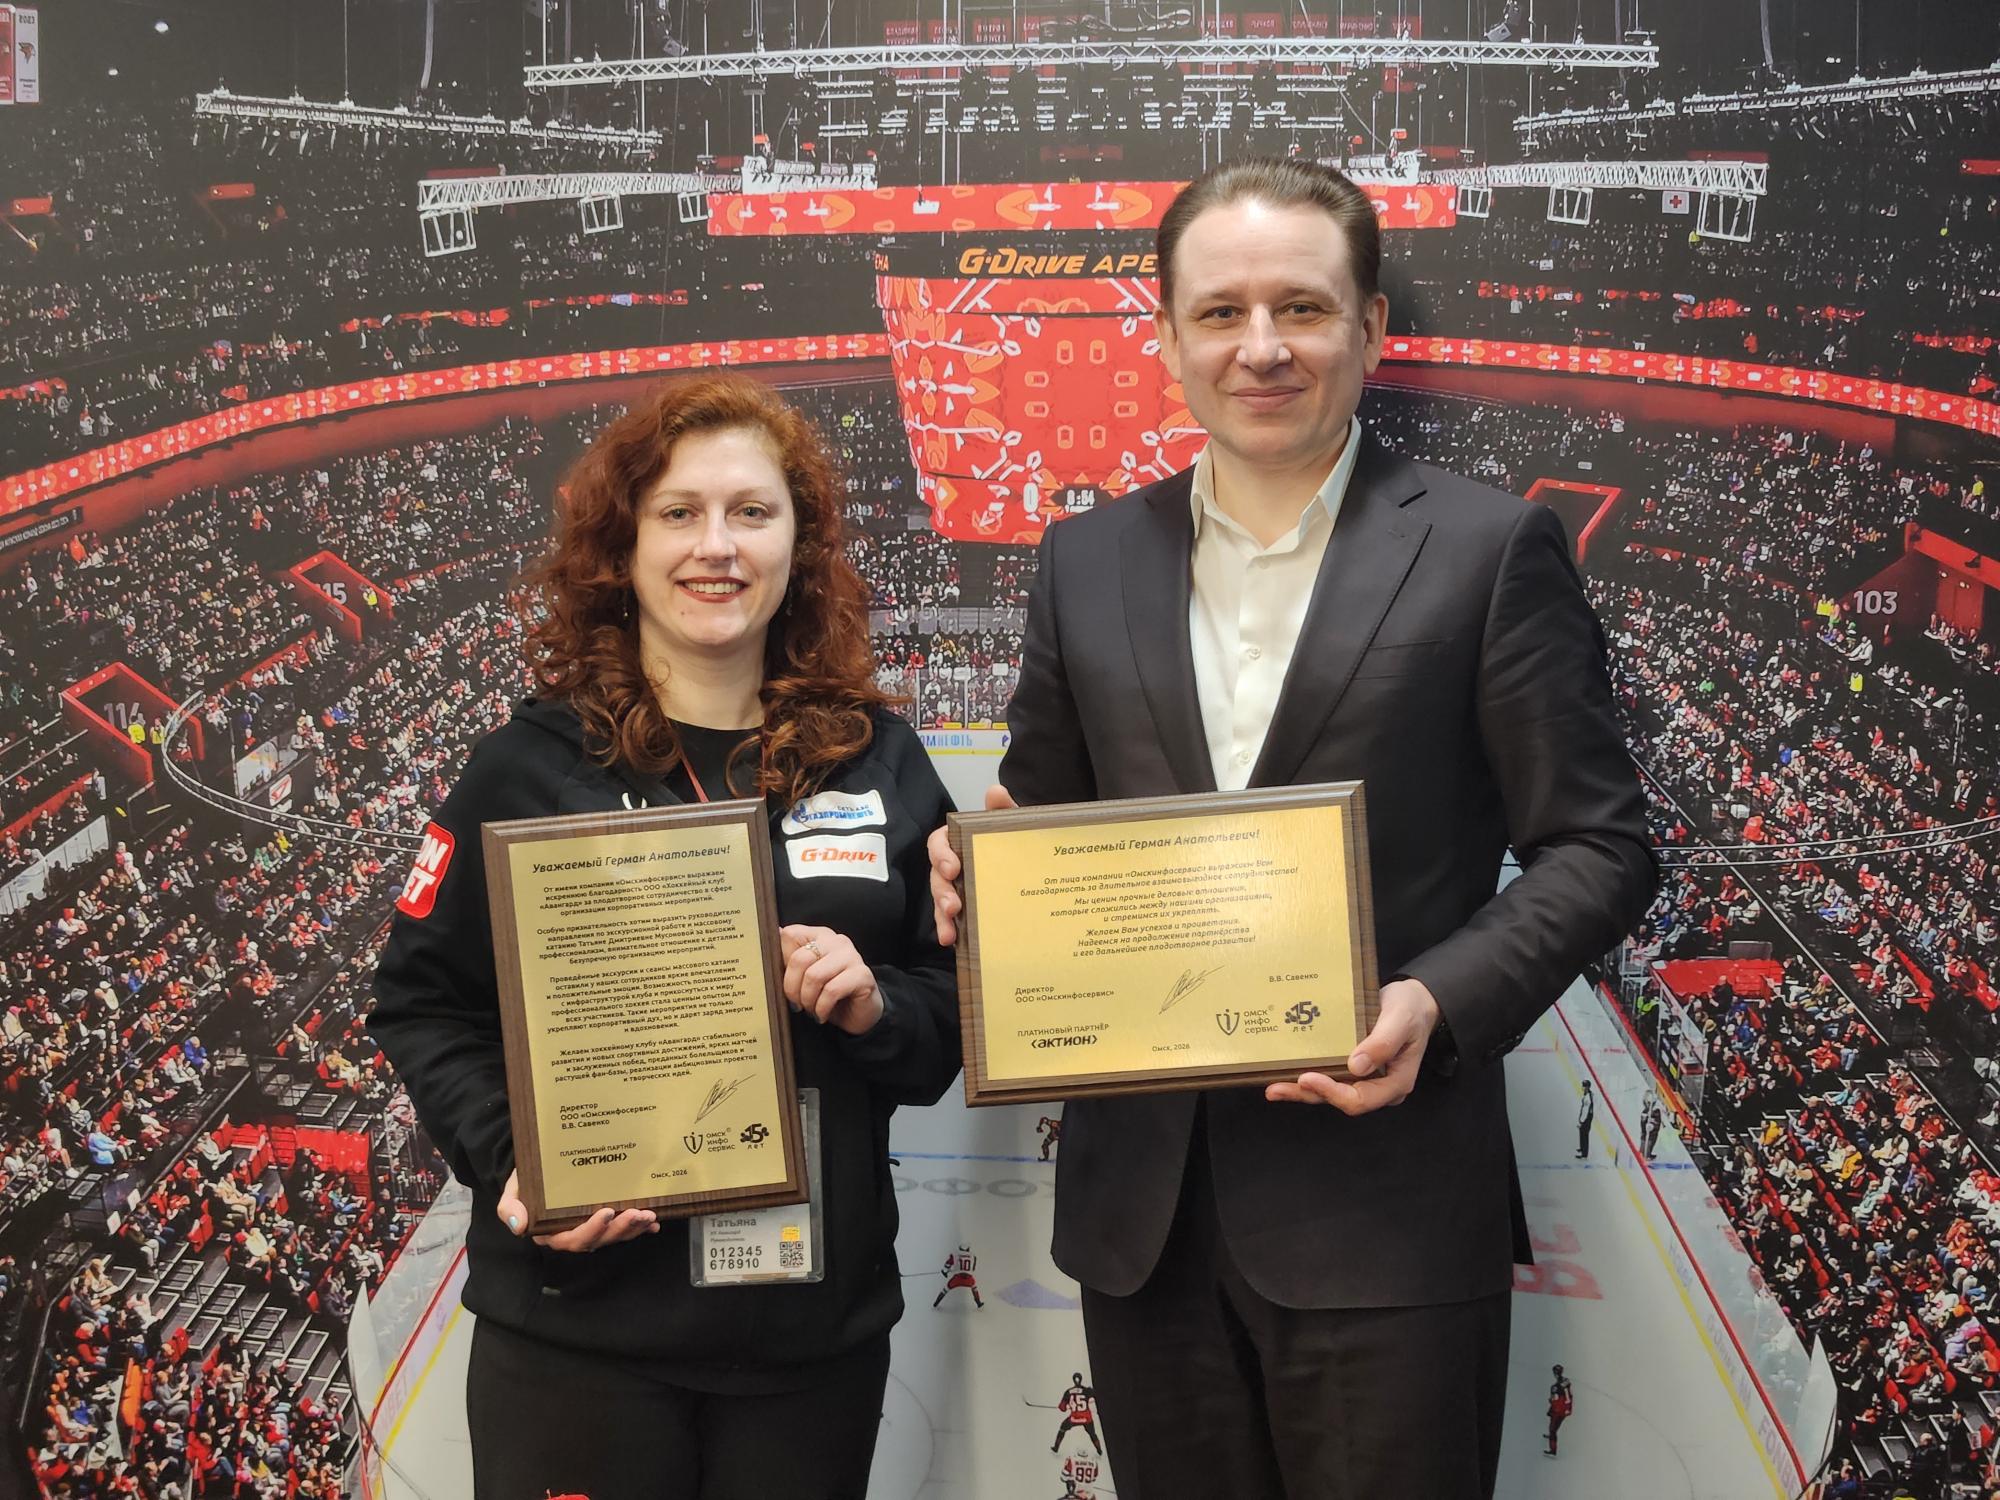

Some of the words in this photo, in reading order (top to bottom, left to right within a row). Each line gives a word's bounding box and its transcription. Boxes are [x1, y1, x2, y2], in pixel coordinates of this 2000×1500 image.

[315, 582, 347, 605] 15
[1853, 590, 1898, 615] 103
[1053, 839, 1125, 855] Уважаемый
[1128, 838, 1170, 850] Герман
[1174, 829, 1259, 845] Анатольевич!
[532, 856, 601, 873] Уважаемый
[605, 855, 645, 866] Герман
[648, 844, 730, 861] Анатольевич!
[687, 870, 724, 878] выражаем
[588, 887, 642, 896] благодарность
[643, 883, 660, 891] ООО
[661, 878, 706, 888] «Хоккейный
[707, 876, 724, 884] клуб
[539, 901, 582, 909] «Авангард»
[592, 894, 644, 904] плодотворное
[646, 888, 702, 898] сотрудничество
[560, 906, 605, 916] организации
[607, 901, 662, 911] корпоративных
[536, 926, 565, 934] Особую
[566, 921, 627, 932] признательность
[688, 909, 740, 920] руководителю
[660, 922, 685, 931] работе
[693, 918, 731, 926] массовому
[608, 934, 652, 944] Дмитриевне
[707, 934, 738, 942] деталям
[569, 954, 616, 964] безупречную
[618, 950, 665, 959] организацию
[549, 973, 599, 983] Проведённые
[601, 969, 638, 977] экскурсии
[672, 961, 709, 969] массового
[1285, 973, 1318, 981] Савенко
[555, 982, 588, 990] оставили
[620, 974, 665, 983] сотрудников
[690, 967, 735, 976] впечатления
[552, 988, 611, 998] положительные
[643, 980, 691, 989] Возможность
[692, 974, 746, 984] познакомиться
[1014, 986, 1054, 996] Директор
[631, 991, 652, 999] клуба
[672, 995, 700, 1003] ценным
[1014, 993, 1034, 1003] ООО
[649, 1004, 696, 1013] мероприятия
[1243, 1009, 1267, 1017] омск
[1244, 1016, 1270, 1025] инфо
[547, 1023, 586, 1034] укрепляют
[1017, 1025, 1072, 1036] ПЛАТИНОВЫЙ
[1073, 1022, 1109, 1032] ПАРТНЁР
[1244, 1024, 1277, 1034] сервис
[1292, 1023, 1313, 1032] лет
[591, 1043, 634, 1052] хоккейному
[635, 1040, 656, 1048] клубу
[658, 1036, 700, 1044] «Авангард»
[702, 1031, 746, 1040] стабильного
[551, 1057, 584, 1066] развития
[616, 1049, 659, 1058] спортивных
[689, 1048, 738, 1058] болельщиков
[554, 1071, 590, 1082] растущей
[723, 1054, 757, 1063] проектов
[629, 1072, 670, 1081] творческих
[559, 1103, 597, 1113] Директор
[560, 1112, 579, 1120] ООО
[577, 1119, 609, 1127] Савенко
[706, 1137, 728, 1145] инфо
[559, 1145, 606, 1156] ПЛАТИНОВЫЙ
[606, 1142, 636, 1150] ПАРТНЁР
[707, 1144, 735, 1152] сервис
[711, 1218, 757, 1228] Татьяна
[710, 1246, 762, 1258] 012345
[710, 1258, 760, 1270] 678910
[1069, 1394, 1087, 1412] 45
[1075, 1467, 1093, 1483] 99
